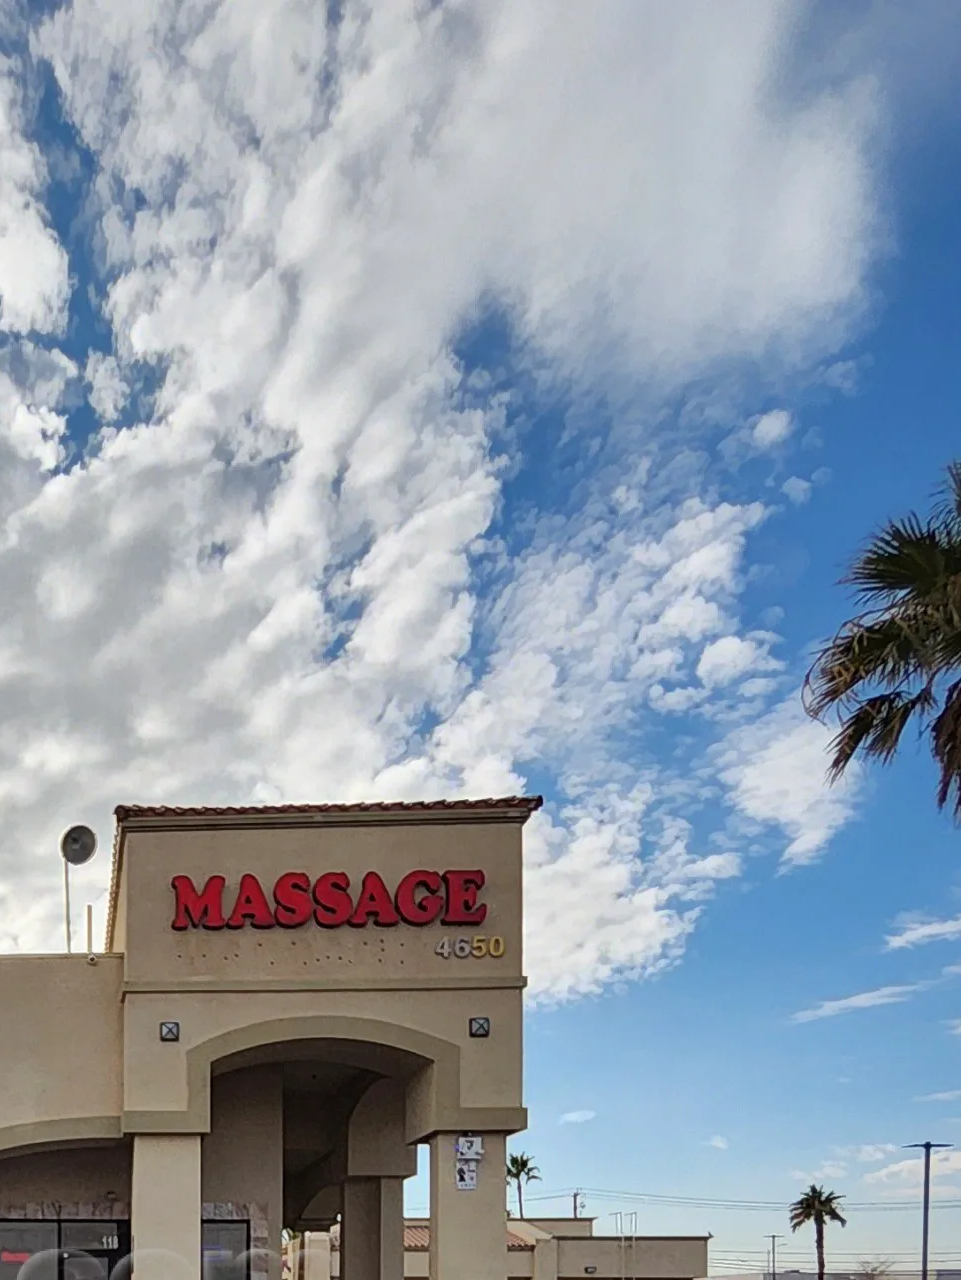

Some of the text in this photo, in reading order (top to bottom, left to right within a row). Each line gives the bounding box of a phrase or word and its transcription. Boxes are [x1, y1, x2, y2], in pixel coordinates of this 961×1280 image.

[171, 870, 487, 931] MASSAGE
[434, 936, 504, 958] 4650
[101, 1235, 119, 1250] 118
